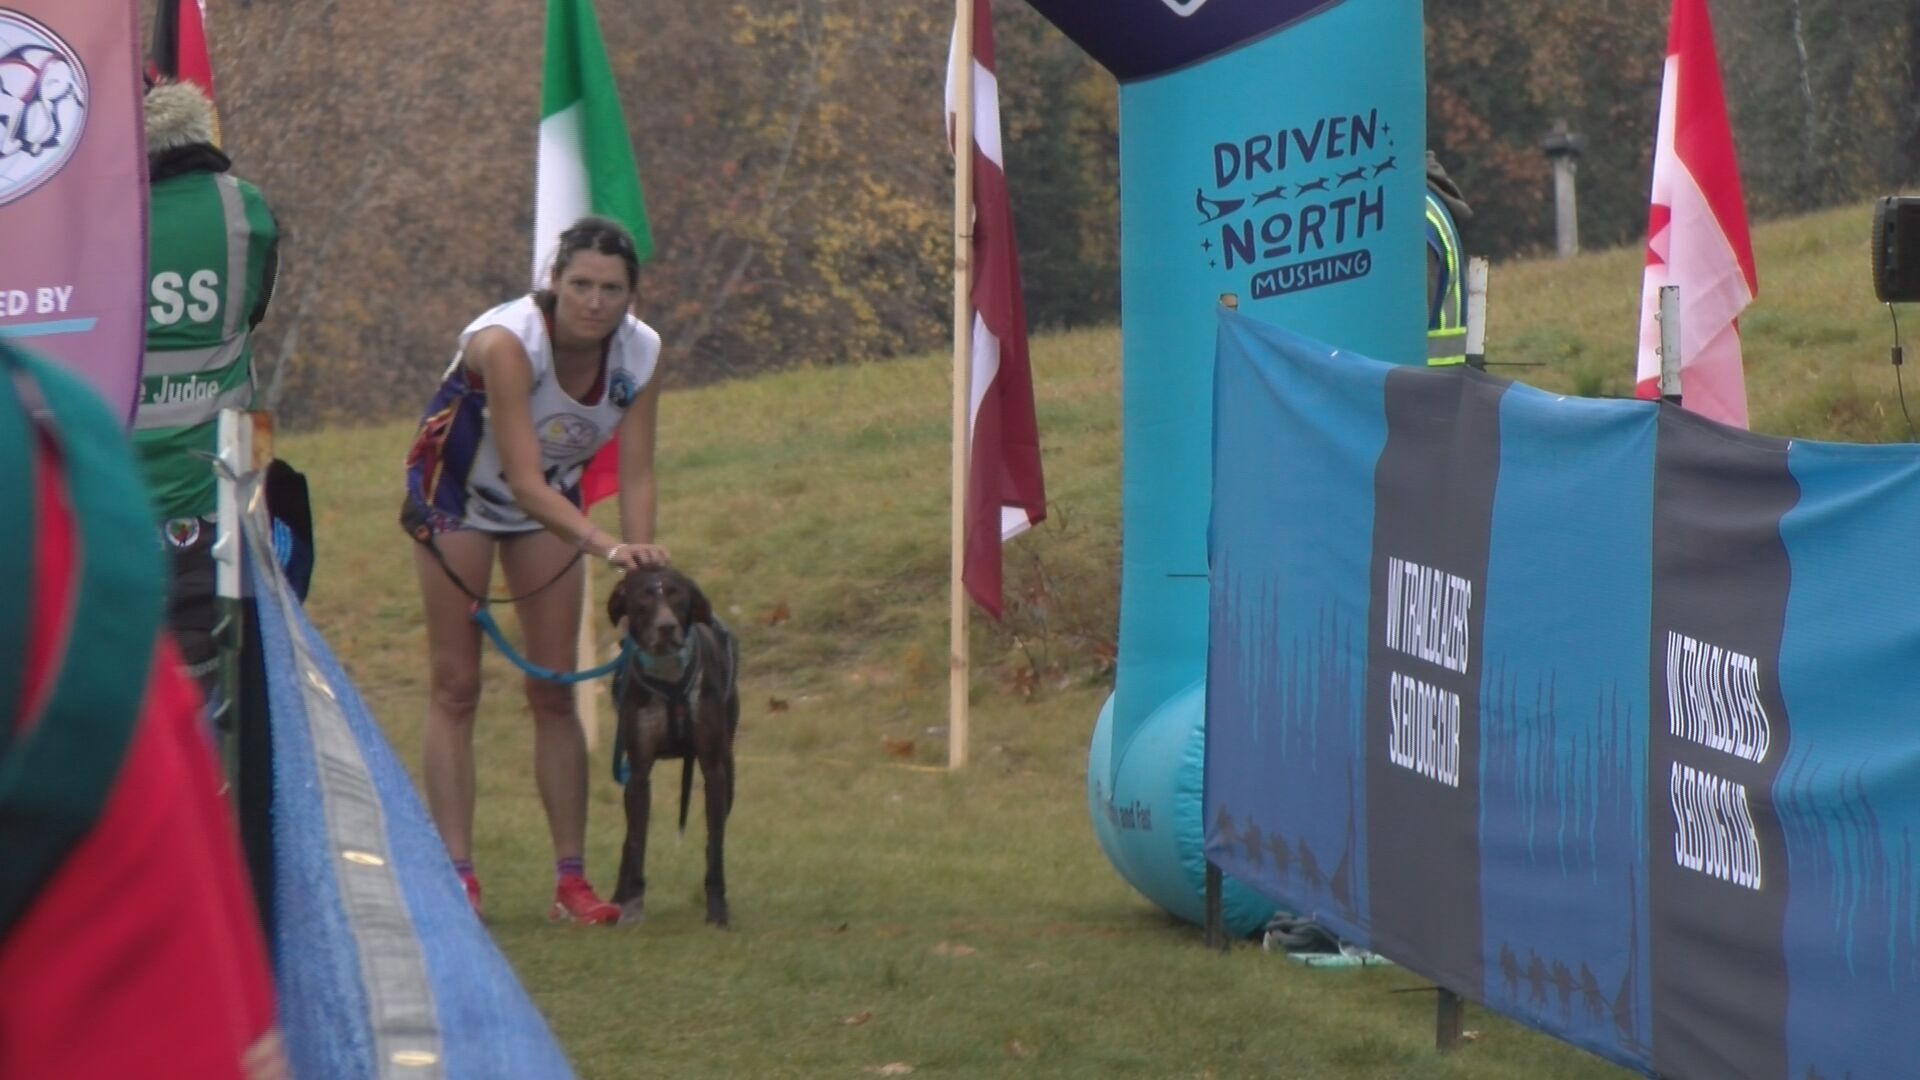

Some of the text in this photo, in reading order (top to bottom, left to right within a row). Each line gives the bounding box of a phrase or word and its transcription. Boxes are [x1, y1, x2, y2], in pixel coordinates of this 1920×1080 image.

[1214, 108, 1377, 189] DRIVEN
[1222, 185, 1384, 270] NORTH
[36, 285, 73, 313] BY
[1256, 253, 1368, 295] MUSHING
[1390, 671, 1460, 788] SLED DOG CLUB
[1683, 636, 1770, 764] TRAILBLAZERS
[1671, 760, 1761, 890] SLED DOG CLUB
